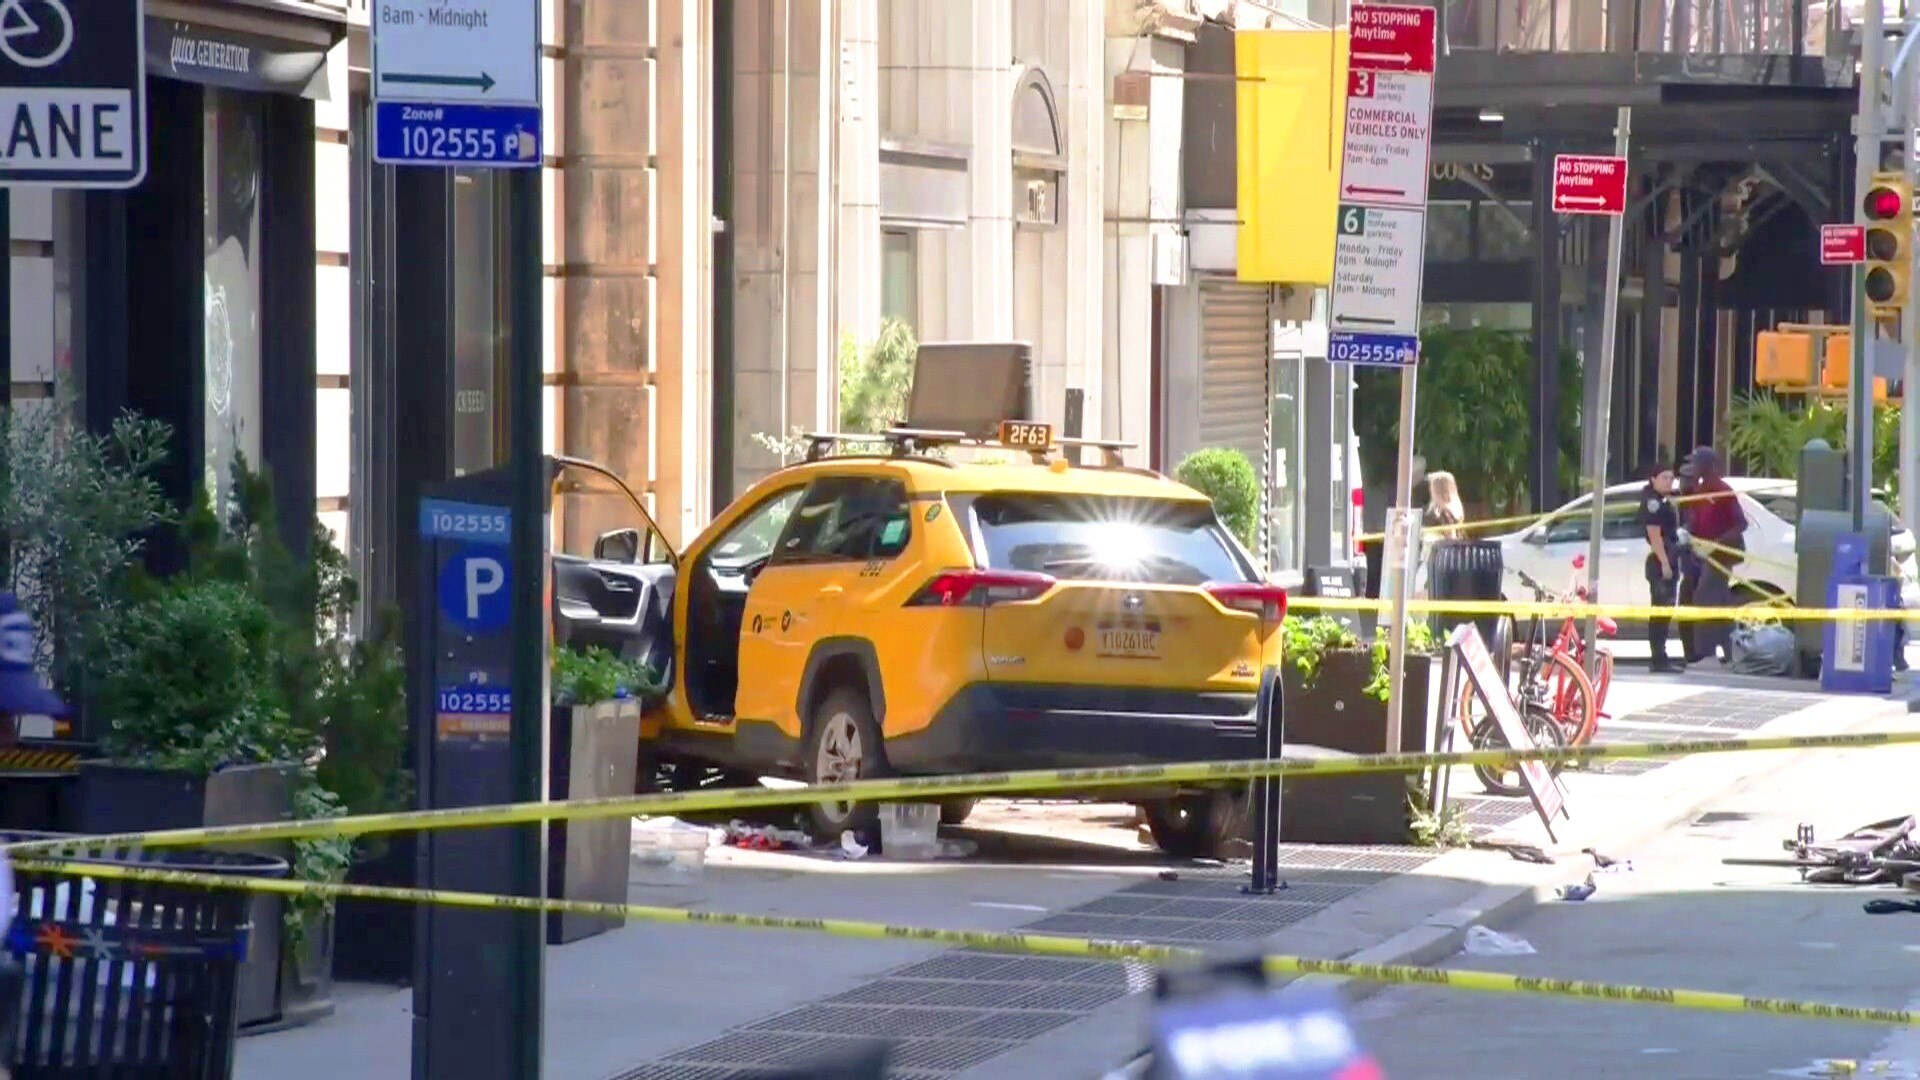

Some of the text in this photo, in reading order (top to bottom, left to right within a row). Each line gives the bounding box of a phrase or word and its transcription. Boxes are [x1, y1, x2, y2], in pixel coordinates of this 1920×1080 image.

[382, 6, 414, 25] 8am
[428, 8, 488, 30] Midnight
[1354, 11, 1421, 26] NO STOPPING
[1354, 26, 1396, 41] Anytime
[197, 40, 250, 73] GENERATION
[1355, 72, 1369, 95] 3
[402, 107, 443, 121] Zone#
[1349, 107, 1417, 124] COMMERCIAL
[0, 103, 122, 158] ANE
[1349, 123, 1426, 139] VEHICLES ONLY
[402, 126, 496, 158] 102555
[1347, 142, 1377, 154] Monday
[1385, 144, 1409, 157] Friday
[1559, 161, 1615, 175] NO STOPPING
[1559, 174, 1594, 188] Anytime
[1344, 208, 1358, 233] 6
[1339, 243, 1370, 255] Monday
[1378, 244, 1403, 257] Friday
[1338, 256, 1357, 266] 6pm
[1364, 256, 1398, 269] Midnight
[1337, 272, 1374, 285] Saturday
[1361, 285, 1396, 298] Midnight
[1331, 343, 1395, 362] 102555
[1010, 424, 1047, 445] 2F63
[433, 514, 505, 532] 102555
[465, 557, 504, 618] P
